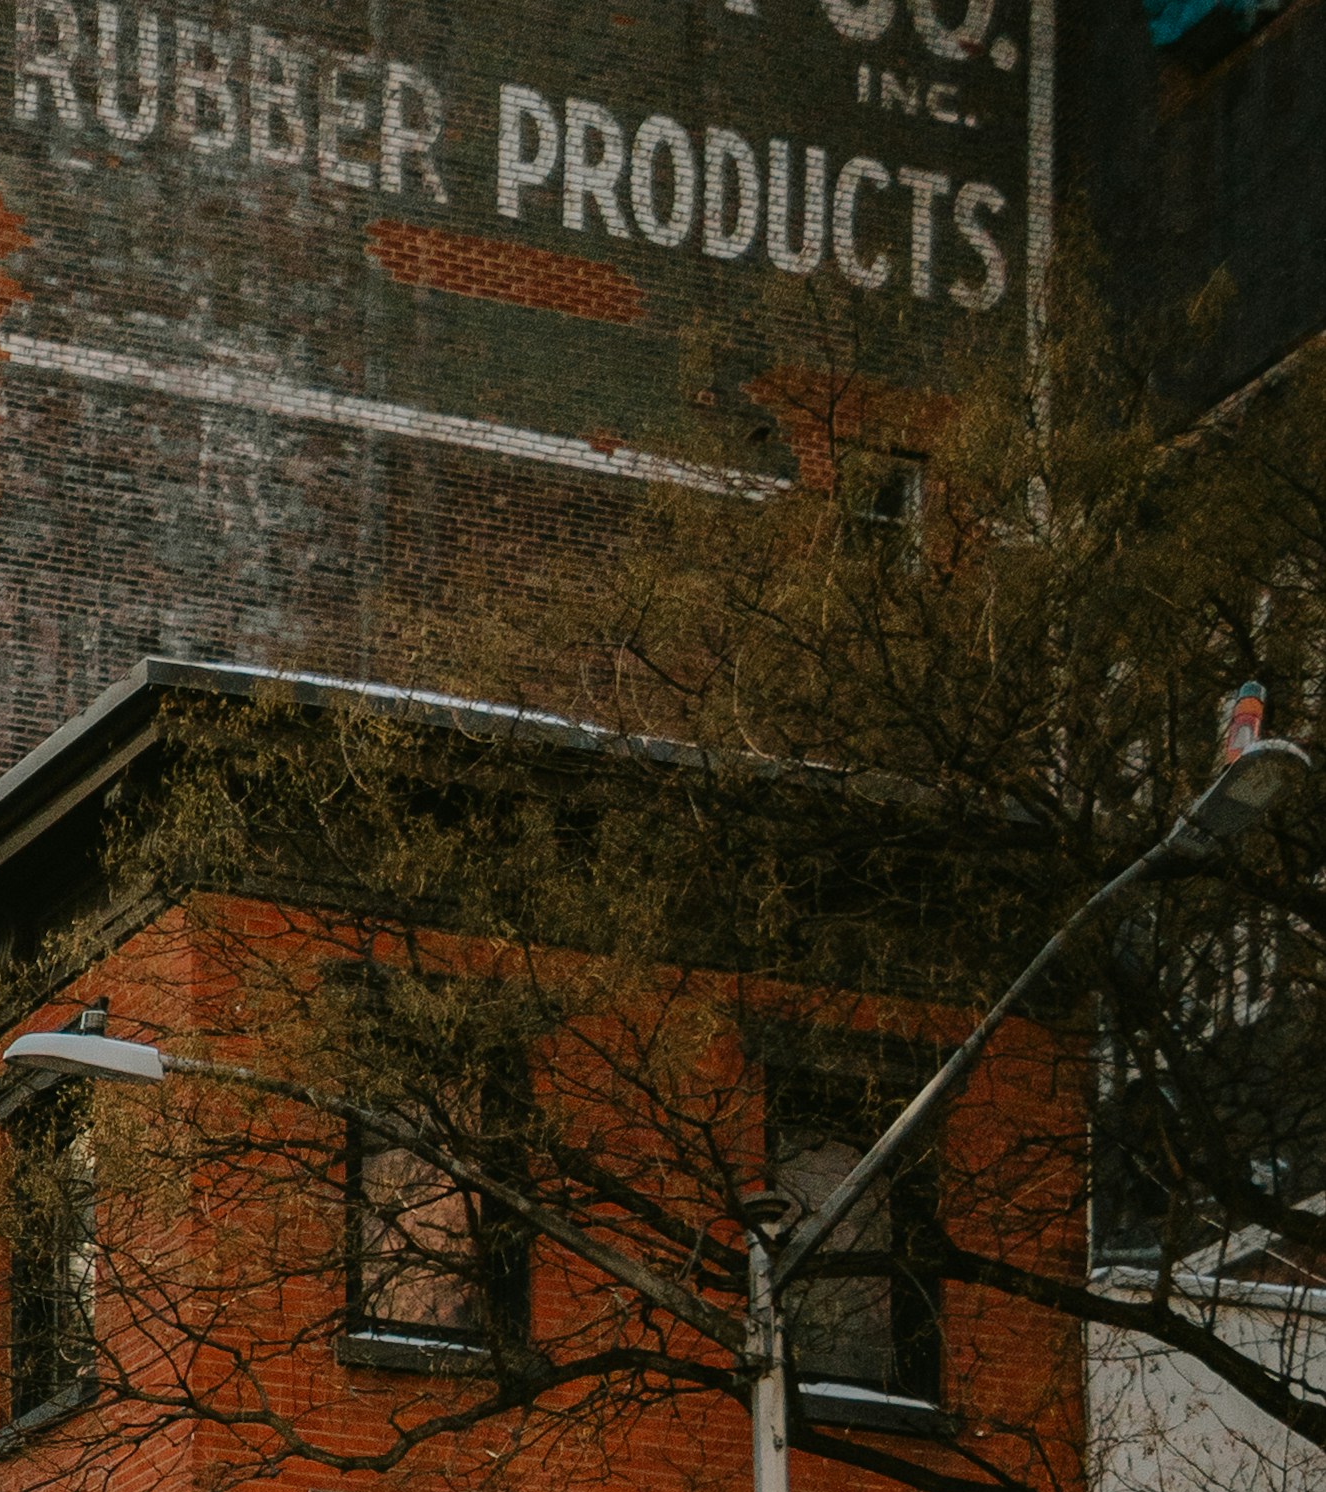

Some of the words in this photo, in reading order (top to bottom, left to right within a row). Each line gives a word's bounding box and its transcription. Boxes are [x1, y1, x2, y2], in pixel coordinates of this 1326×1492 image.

[14, 0, 448, 204] RUBBER
[497, 83, 1009, 311] PRODUCTS
[857, 64, 976, 128] INC.
